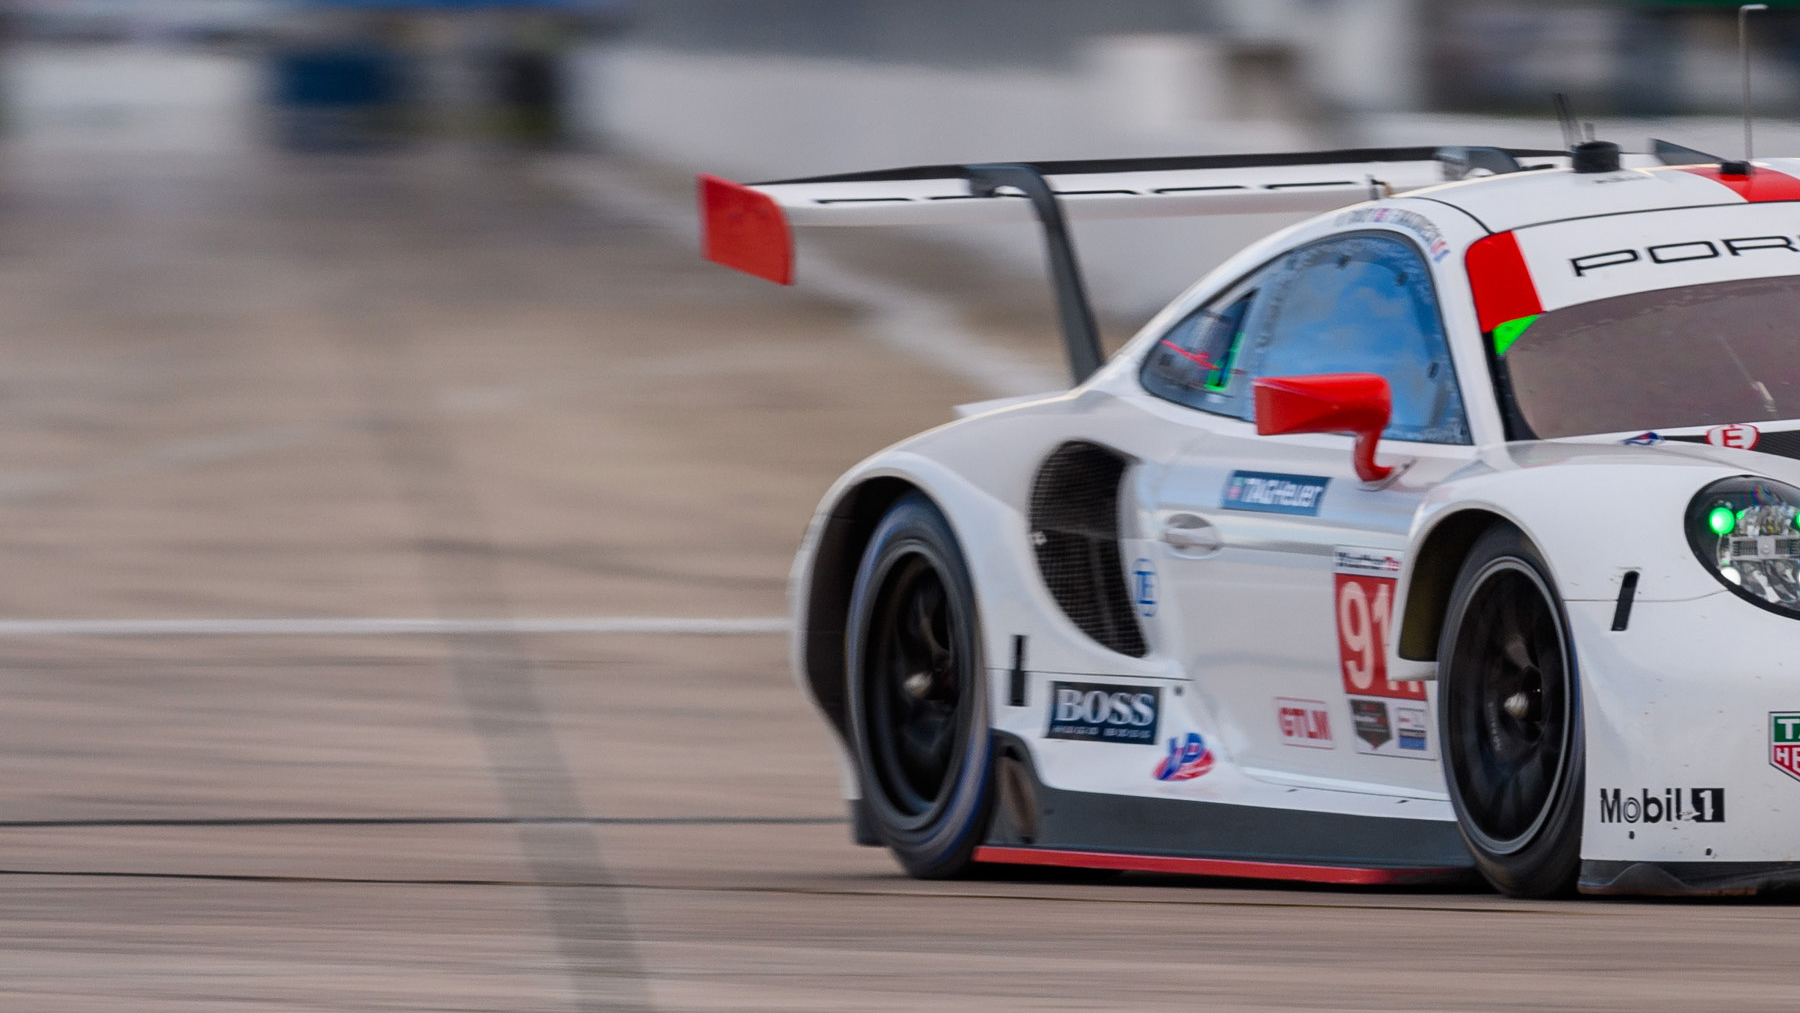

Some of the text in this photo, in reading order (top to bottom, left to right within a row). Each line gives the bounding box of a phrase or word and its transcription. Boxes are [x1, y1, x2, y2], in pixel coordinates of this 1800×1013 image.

[1340, 580, 1420, 692] 91
[1054, 689, 1155, 726] BOSS
[1278, 707, 1332, 740] GTLM
[1600, 788, 1682, 823] Mobil
